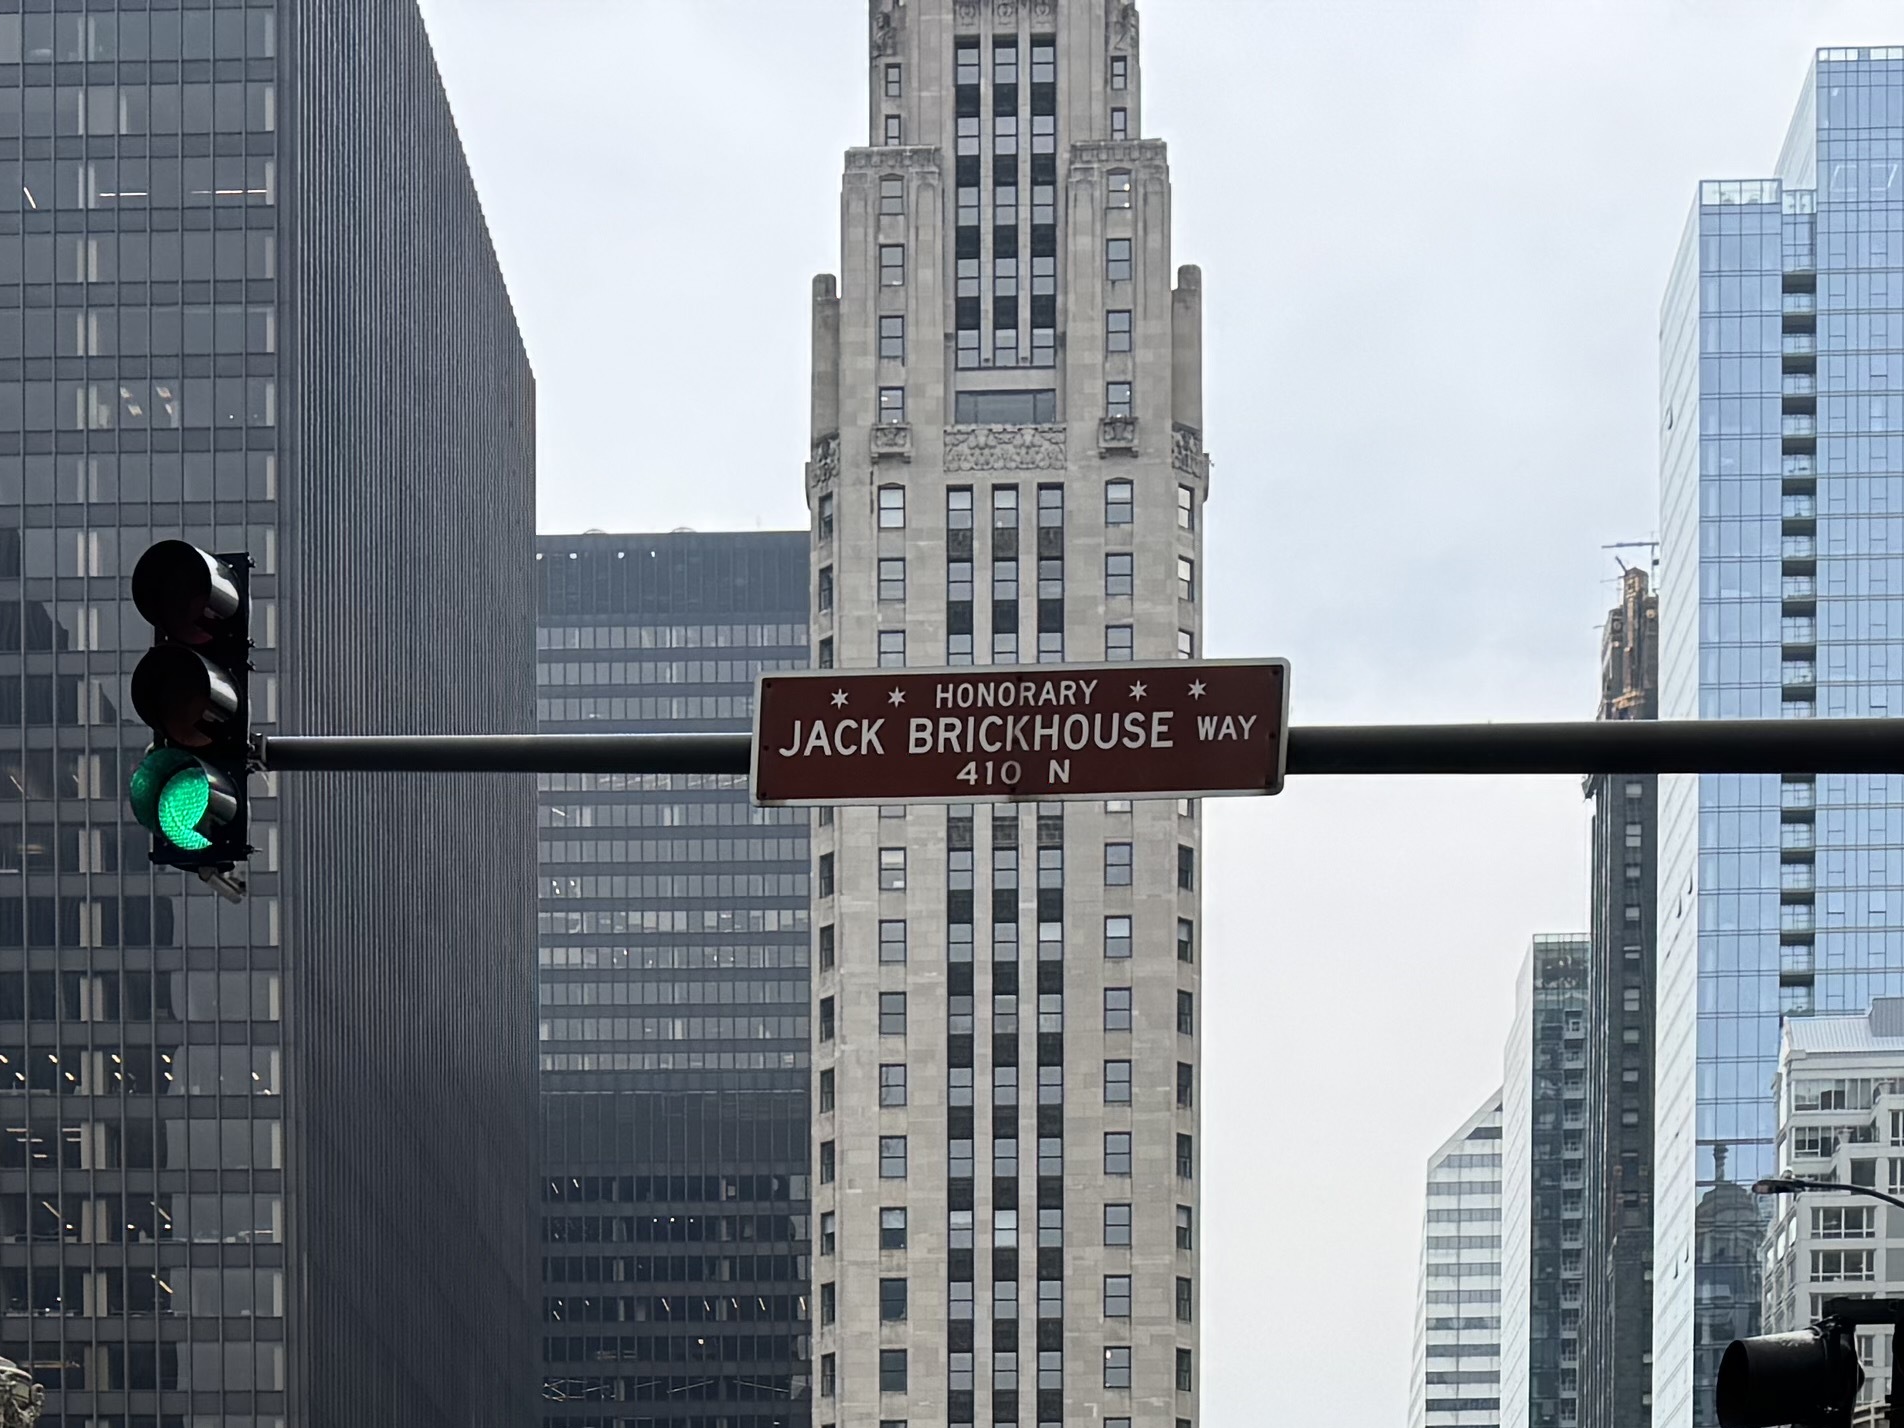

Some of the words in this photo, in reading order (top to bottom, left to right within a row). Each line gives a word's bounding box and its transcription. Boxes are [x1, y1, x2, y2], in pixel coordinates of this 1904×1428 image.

[935, 679, 1099, 709] HONORARY
[779, 718, 886, 757] JACK
[907, 711, 1175, 755] BRICKHOUSE
[1196, 714, 1258, 742] WAY
[955, 759, 1022, 786] 410
[1049, 758, 1071, 784] N
